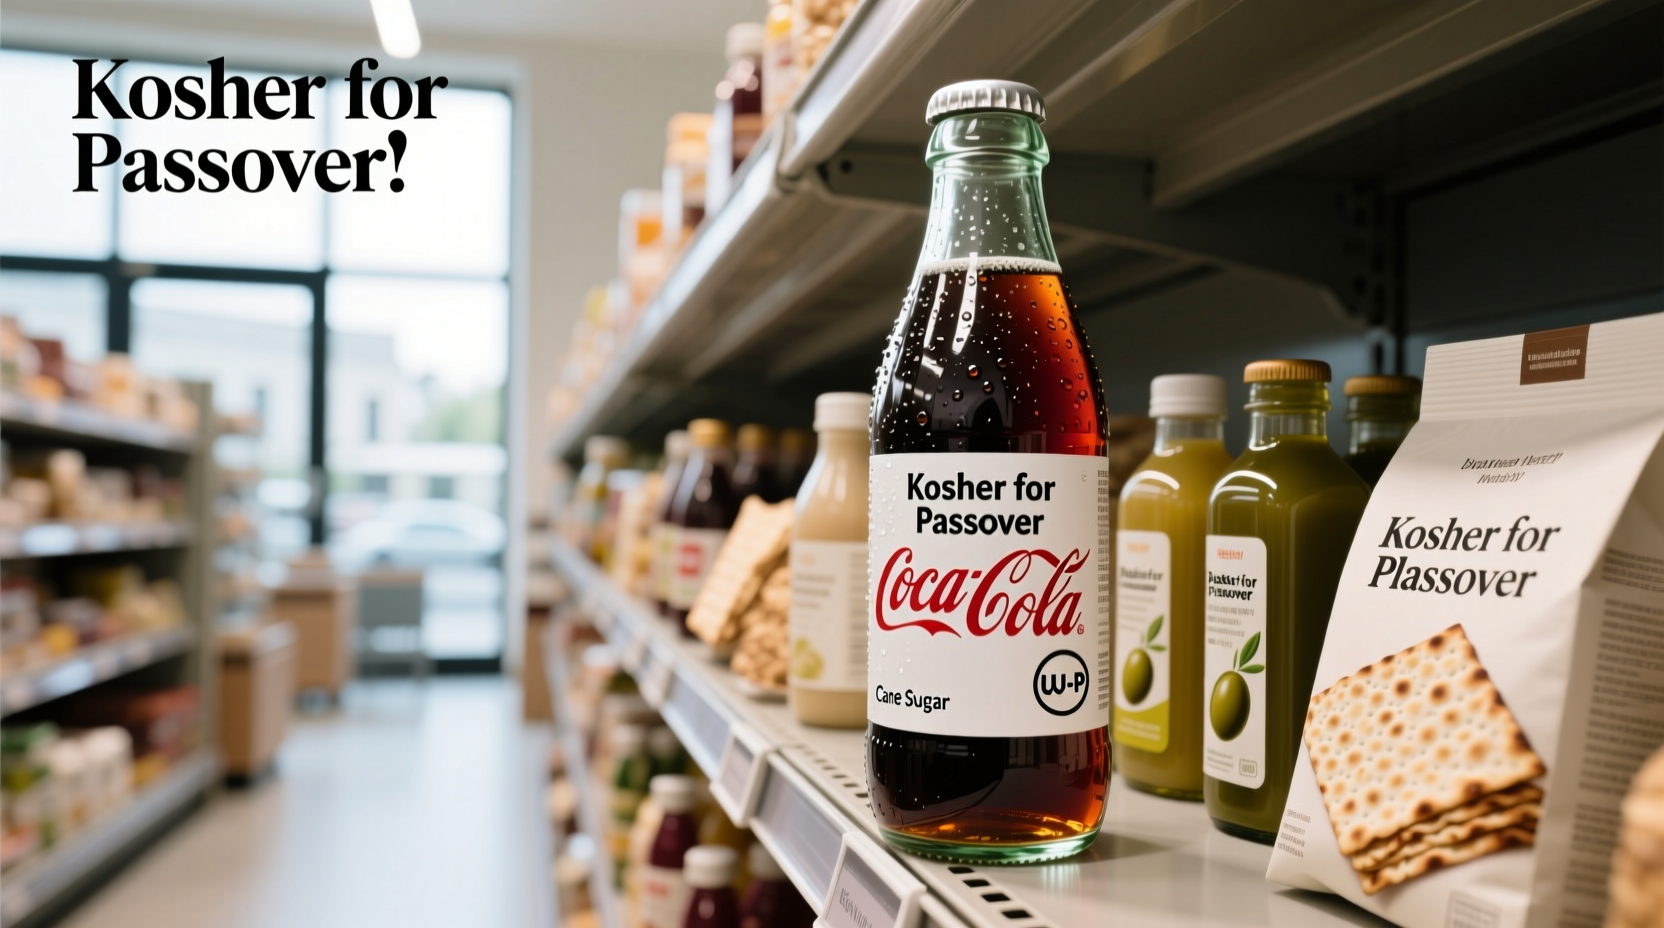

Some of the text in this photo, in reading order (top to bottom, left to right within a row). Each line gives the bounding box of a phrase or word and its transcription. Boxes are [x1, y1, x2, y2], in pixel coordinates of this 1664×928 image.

[907, 472, 1056, 501] Kosher for
[916, 506, 1045, 535] Passover
[1379, 515, 1561, 552] Kosher for
[875, 547, 1091, 638] Coca-Cola
[1368, 555, 1537, 598] Plassover
[875, 685, 951, 713] Cane Sugar
